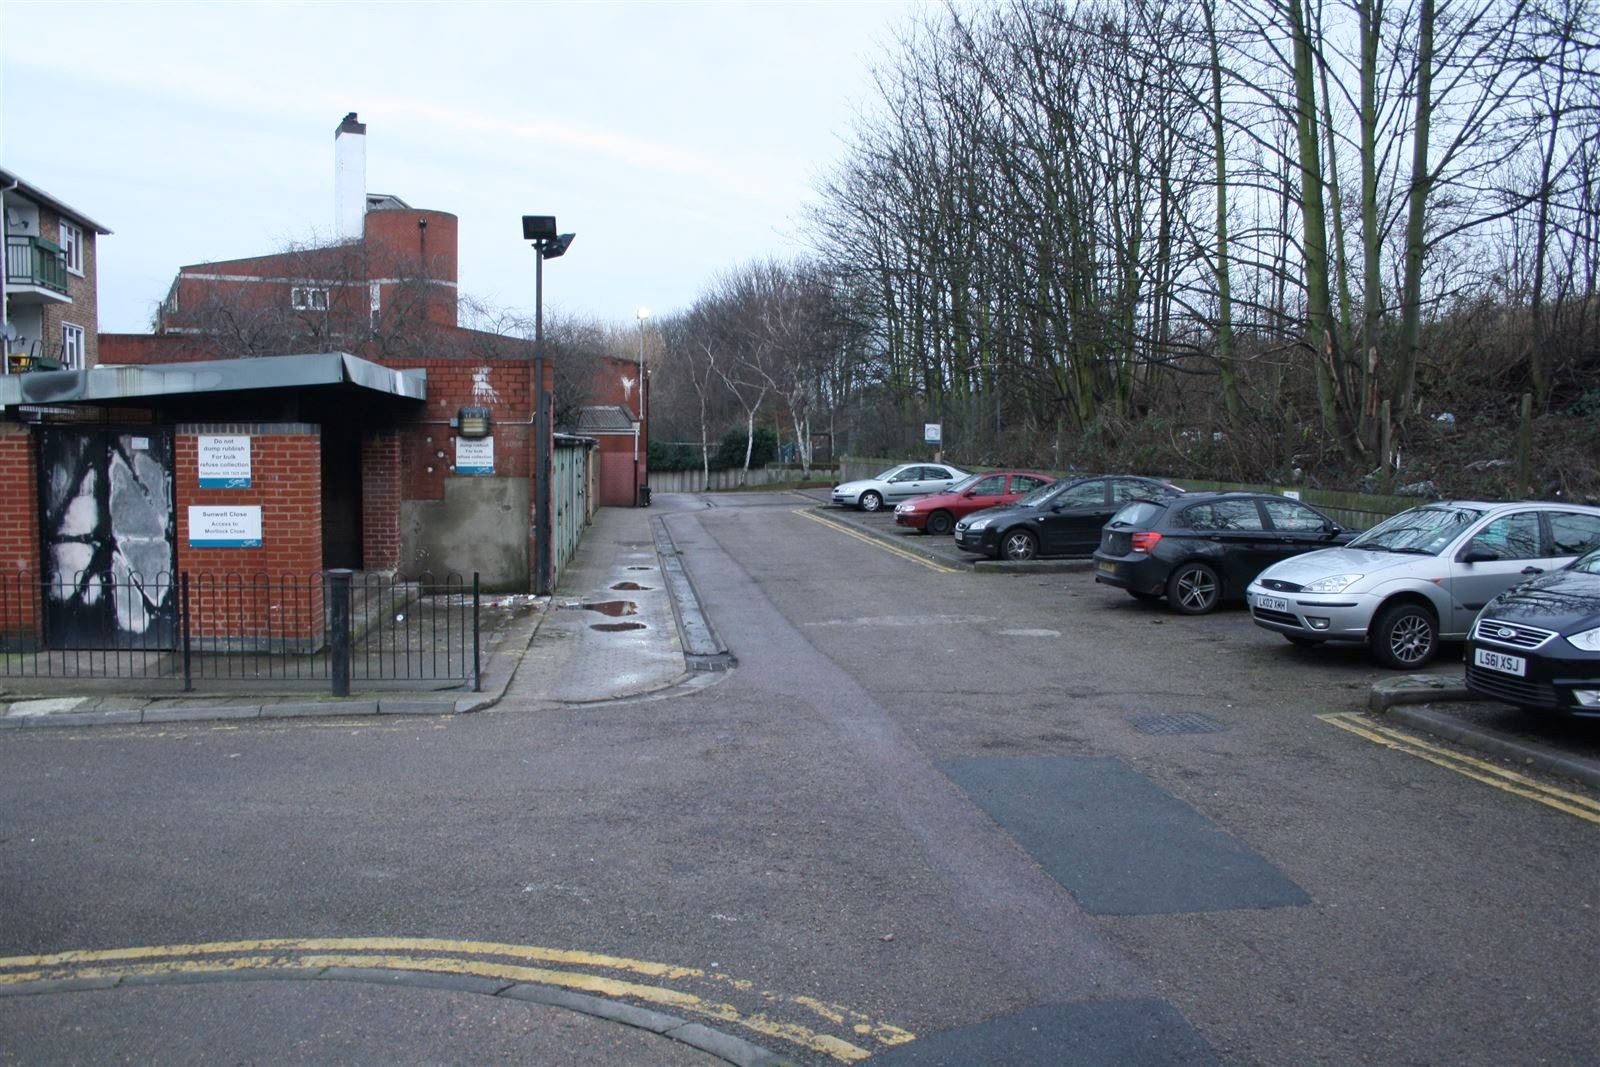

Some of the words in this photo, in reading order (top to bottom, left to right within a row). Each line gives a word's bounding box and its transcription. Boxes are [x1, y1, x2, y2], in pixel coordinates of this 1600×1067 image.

[1259, 596, 1273, 608] LK02
[1480, 651, 1499, 667] LS61
[1500, 655, 1519, 672] XSJ
